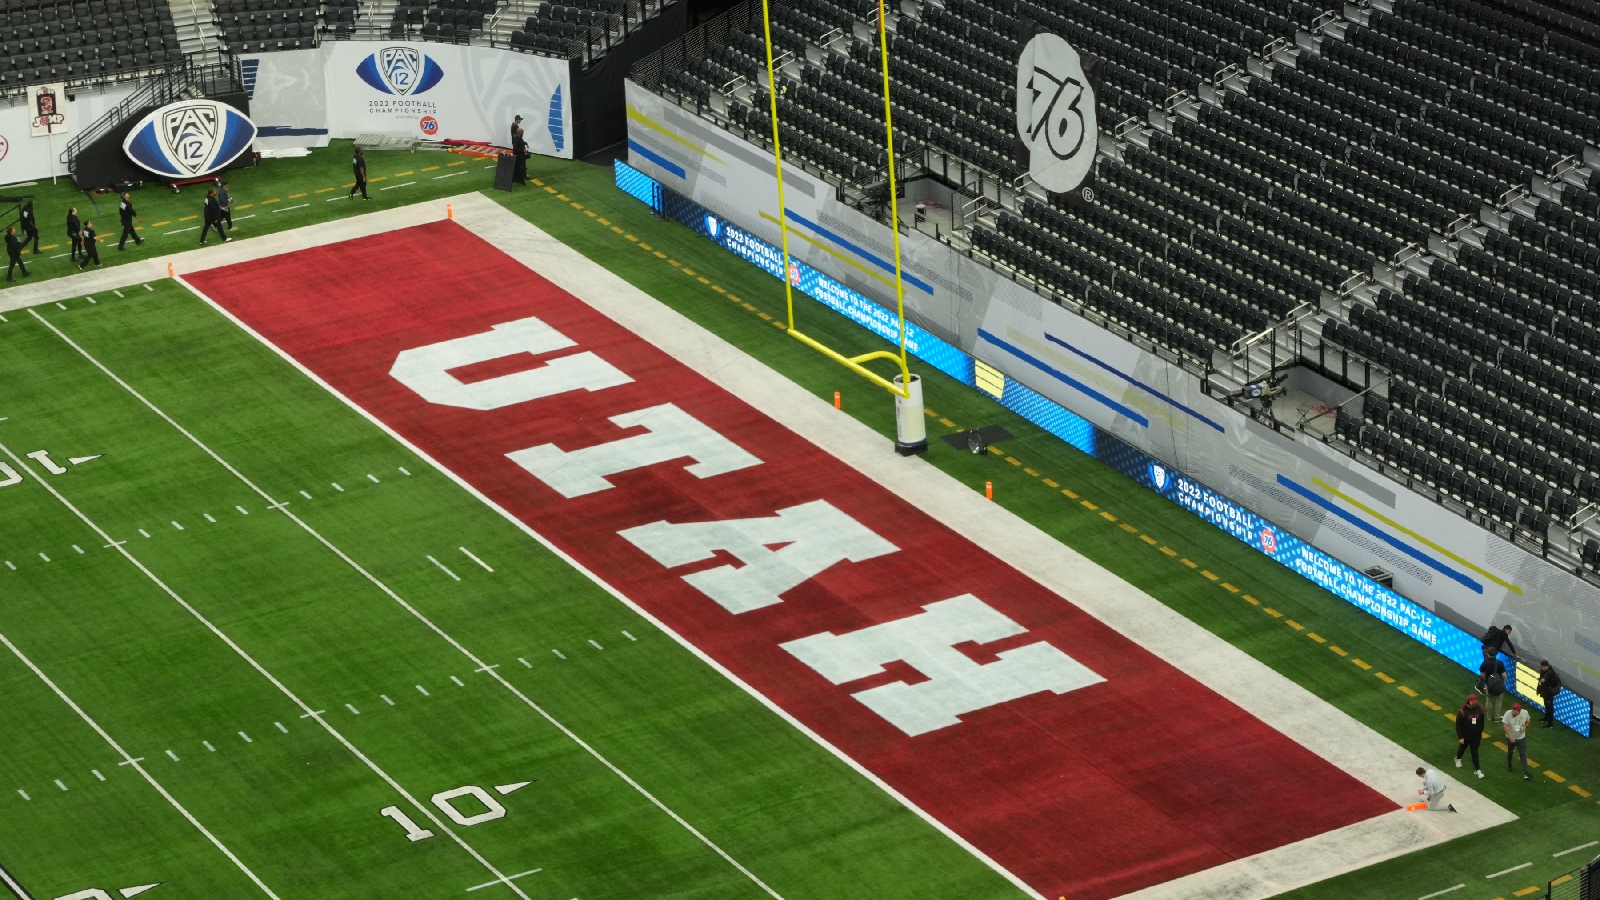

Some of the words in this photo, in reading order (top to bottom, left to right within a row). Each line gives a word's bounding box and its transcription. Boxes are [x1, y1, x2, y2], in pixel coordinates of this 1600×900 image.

[383, 49, 417, 77] PAC
[395, 72, 409, 85] 12
[33, 114, 64, 128] JUMP
[392, 100, 437, 108] FOOTBALL
[1026, 66, 1085, 160] 76
[165, 108, 216, 148] PAC
[423, 121, 436, 131] 76
[184, 141, 204, 160] 12
[726, 226, 744, 243] 2022
[745, 236, 783, 265] FOOTBALL
[727, 238, 783, 274] CHAMPIONSHIP
[815, 287, 846, 311] FOOTBALL
[848, 305, 898, 339] CHAMPIONSHIP
[818, 277, 849, 300] WELCOME
[850, 294, 858, 305] TO
[860, 300, 872, 313] THE
[874, 308, 889, 323] 2022
[890, 317, 914, 337] PA-12
[1178, 478, 1201, 499] 2022
[1203, 492, 1253, 529] FOOTBALL
[1178, 493, 1253, 540] CHAMPIONSHIP
[389, 316, 1107, 737] UTAH
[1263, 534, 1273, 547] 76
[1296, 558, 1339, 590] FOOTBALL
[1341, 584, 1409, 627] CHAMPIONSHIP
[1411, 623, 1437, 645] GAME
[1301, 547, 1342, 576] WELCOME
[1344, 571, 1355, 585] TO
[1357, 579, 1373, 595] THE
[1376, 589, 1397, 608] 2022
[1400, 602, 1432, 628] PAC-12
[379, 784, 508, 843] 10
